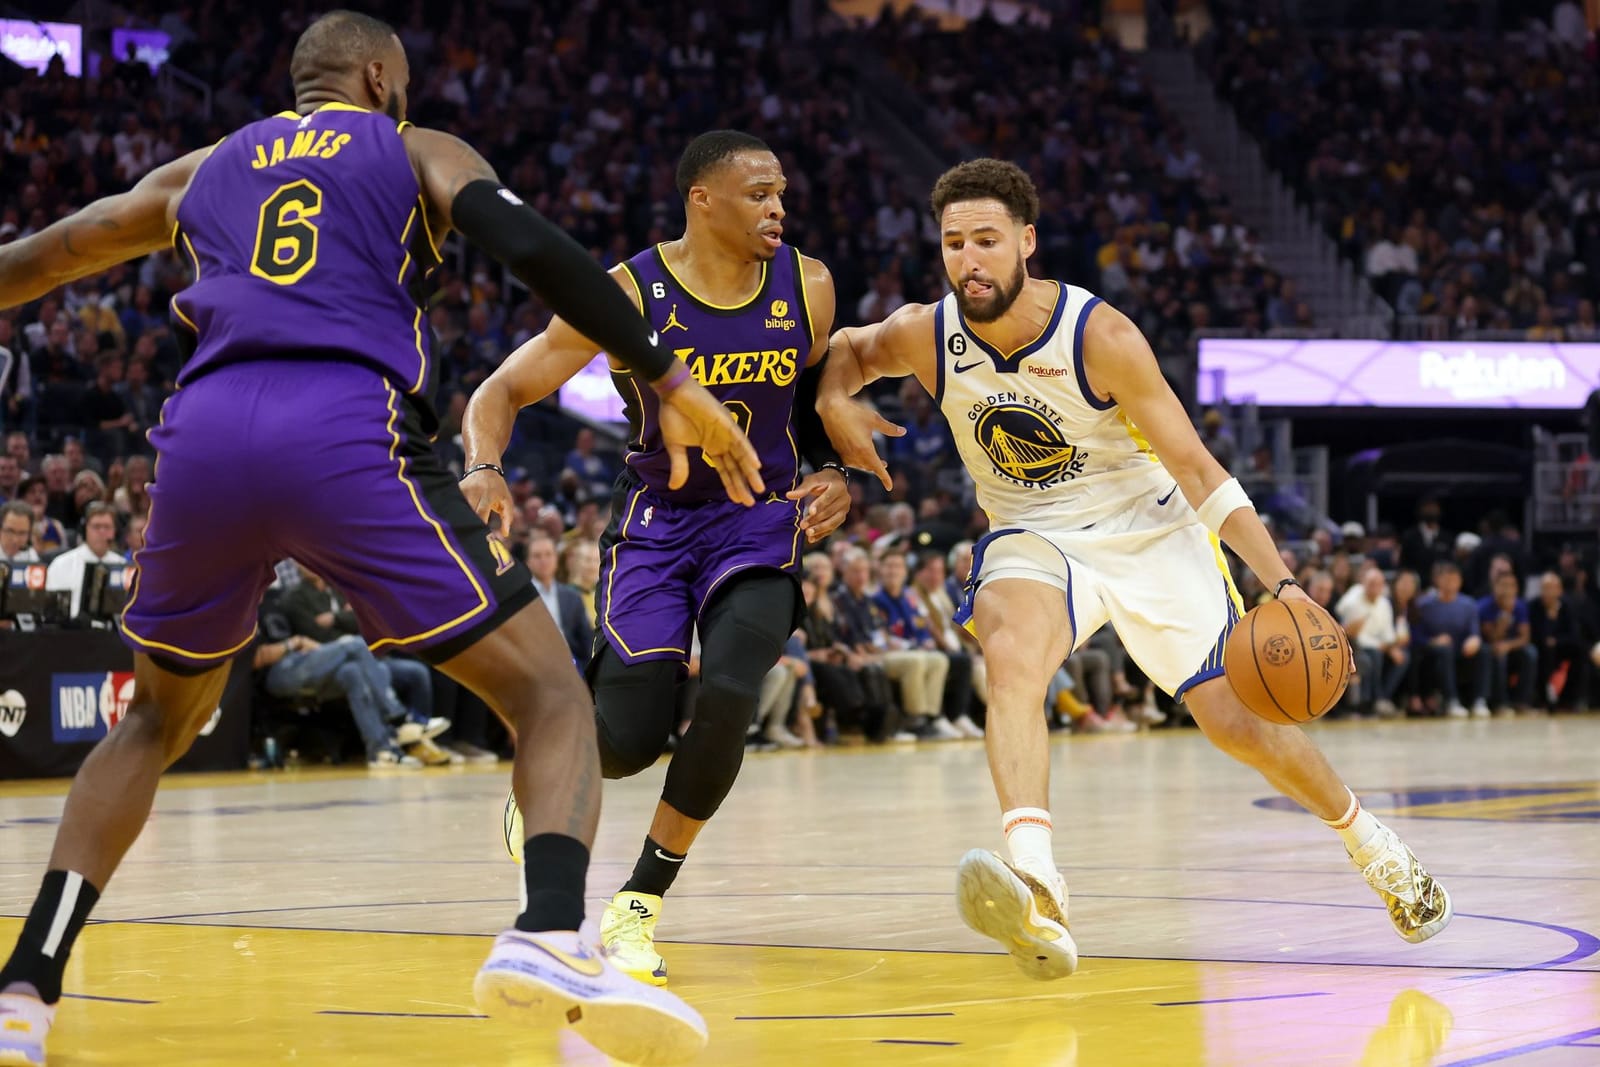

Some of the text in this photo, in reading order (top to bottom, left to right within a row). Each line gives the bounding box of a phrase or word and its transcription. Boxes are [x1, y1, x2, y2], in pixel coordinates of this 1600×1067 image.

[252, 130, 352, 169] JAMES
[250, 178, 323, 286] 6
[652, 282, 666, 299] 6
[765, 318, 796, 331] bibigo
[953, 335, 964, 352] 6
[1028, 365, 1068, 377] Rakuten
[968, 391, 1064, 426] GOLDEN STATE
[992, 451, 1089, 491] RIORS
[59, 685, 97, 729] NBA
